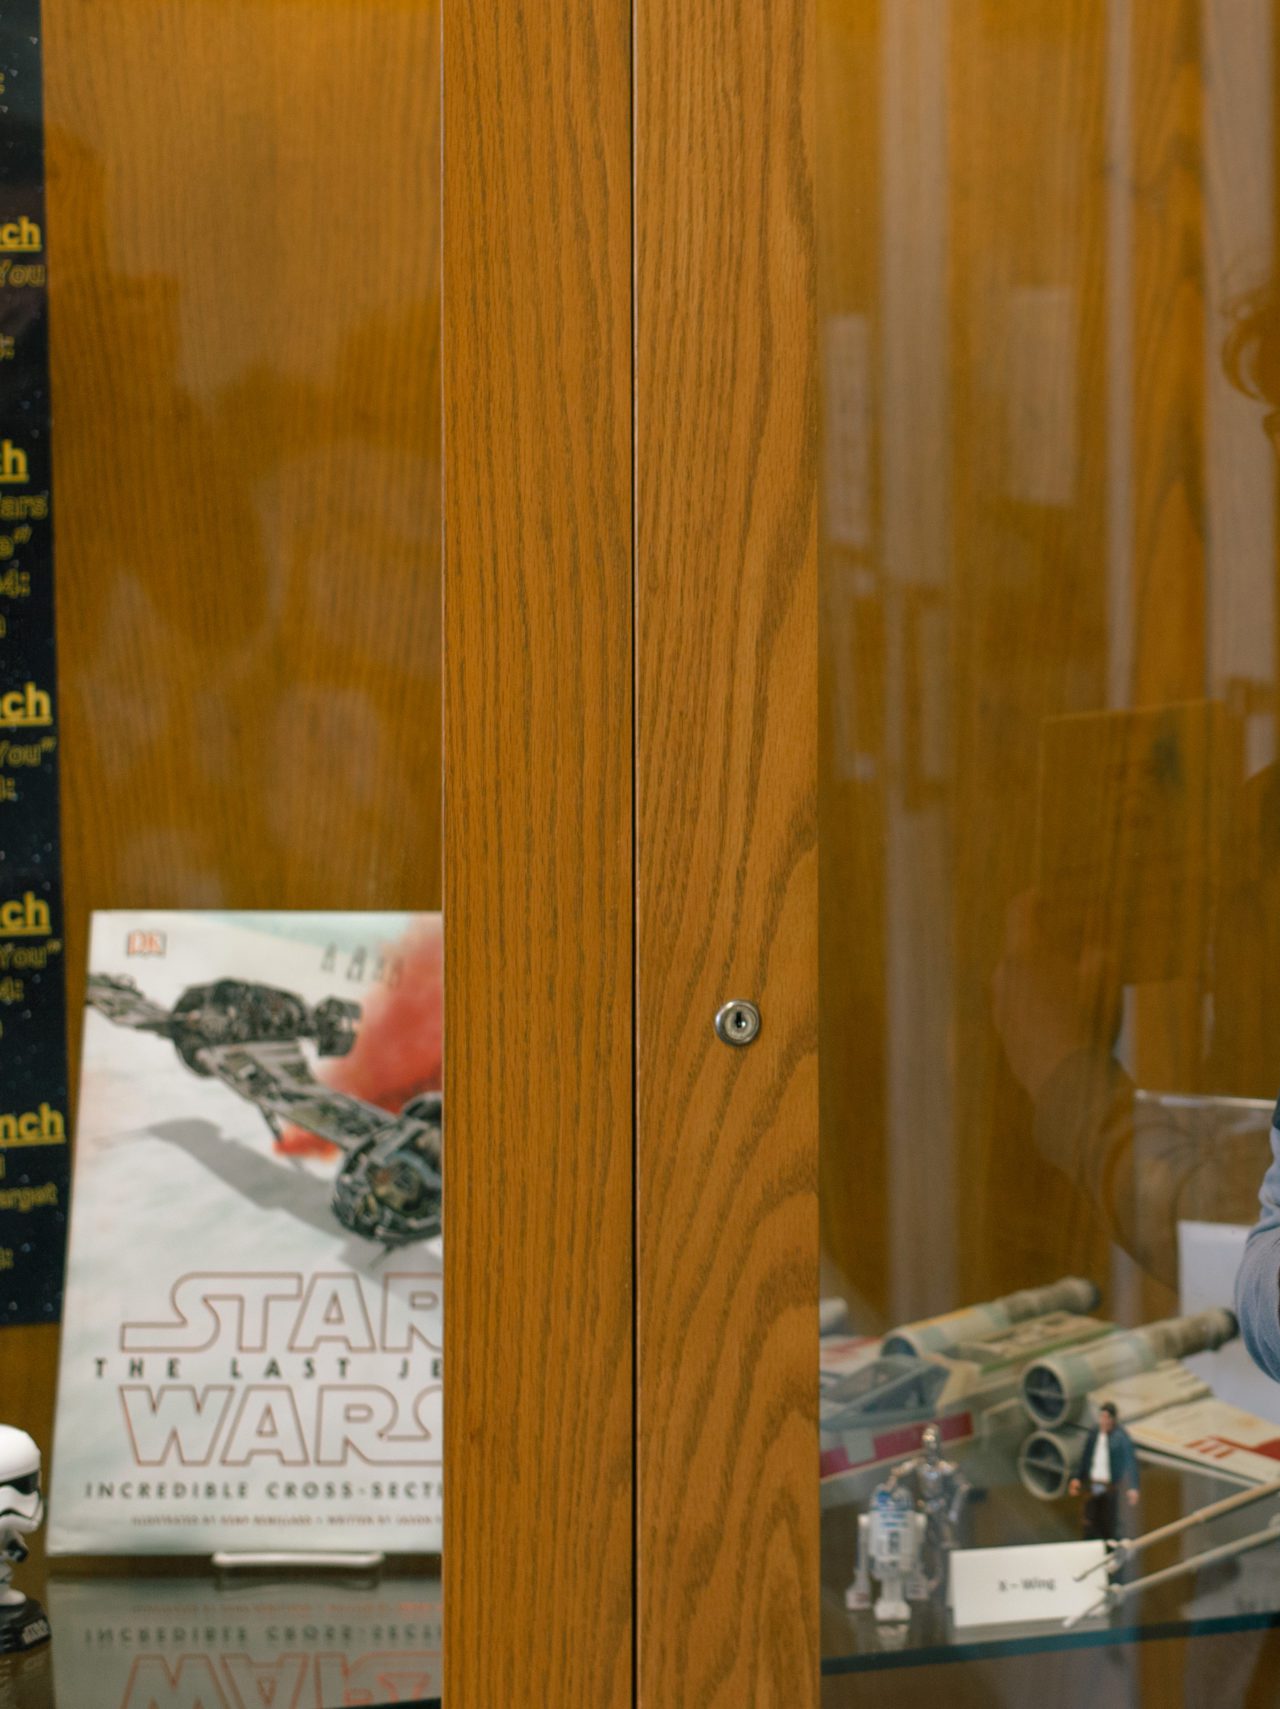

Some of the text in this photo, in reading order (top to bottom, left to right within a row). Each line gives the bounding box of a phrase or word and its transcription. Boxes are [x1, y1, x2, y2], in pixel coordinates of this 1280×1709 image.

[0, 216, 42, 250] ch
[0, 681, 52, 726] ch
[0, 890, 51, 936] ch
[0, 1103, 65, 1147] nch
[94, 1358, 442, 1379] THE LAST JE
[84, 1481, 249, 1499] INCREDIBLE
